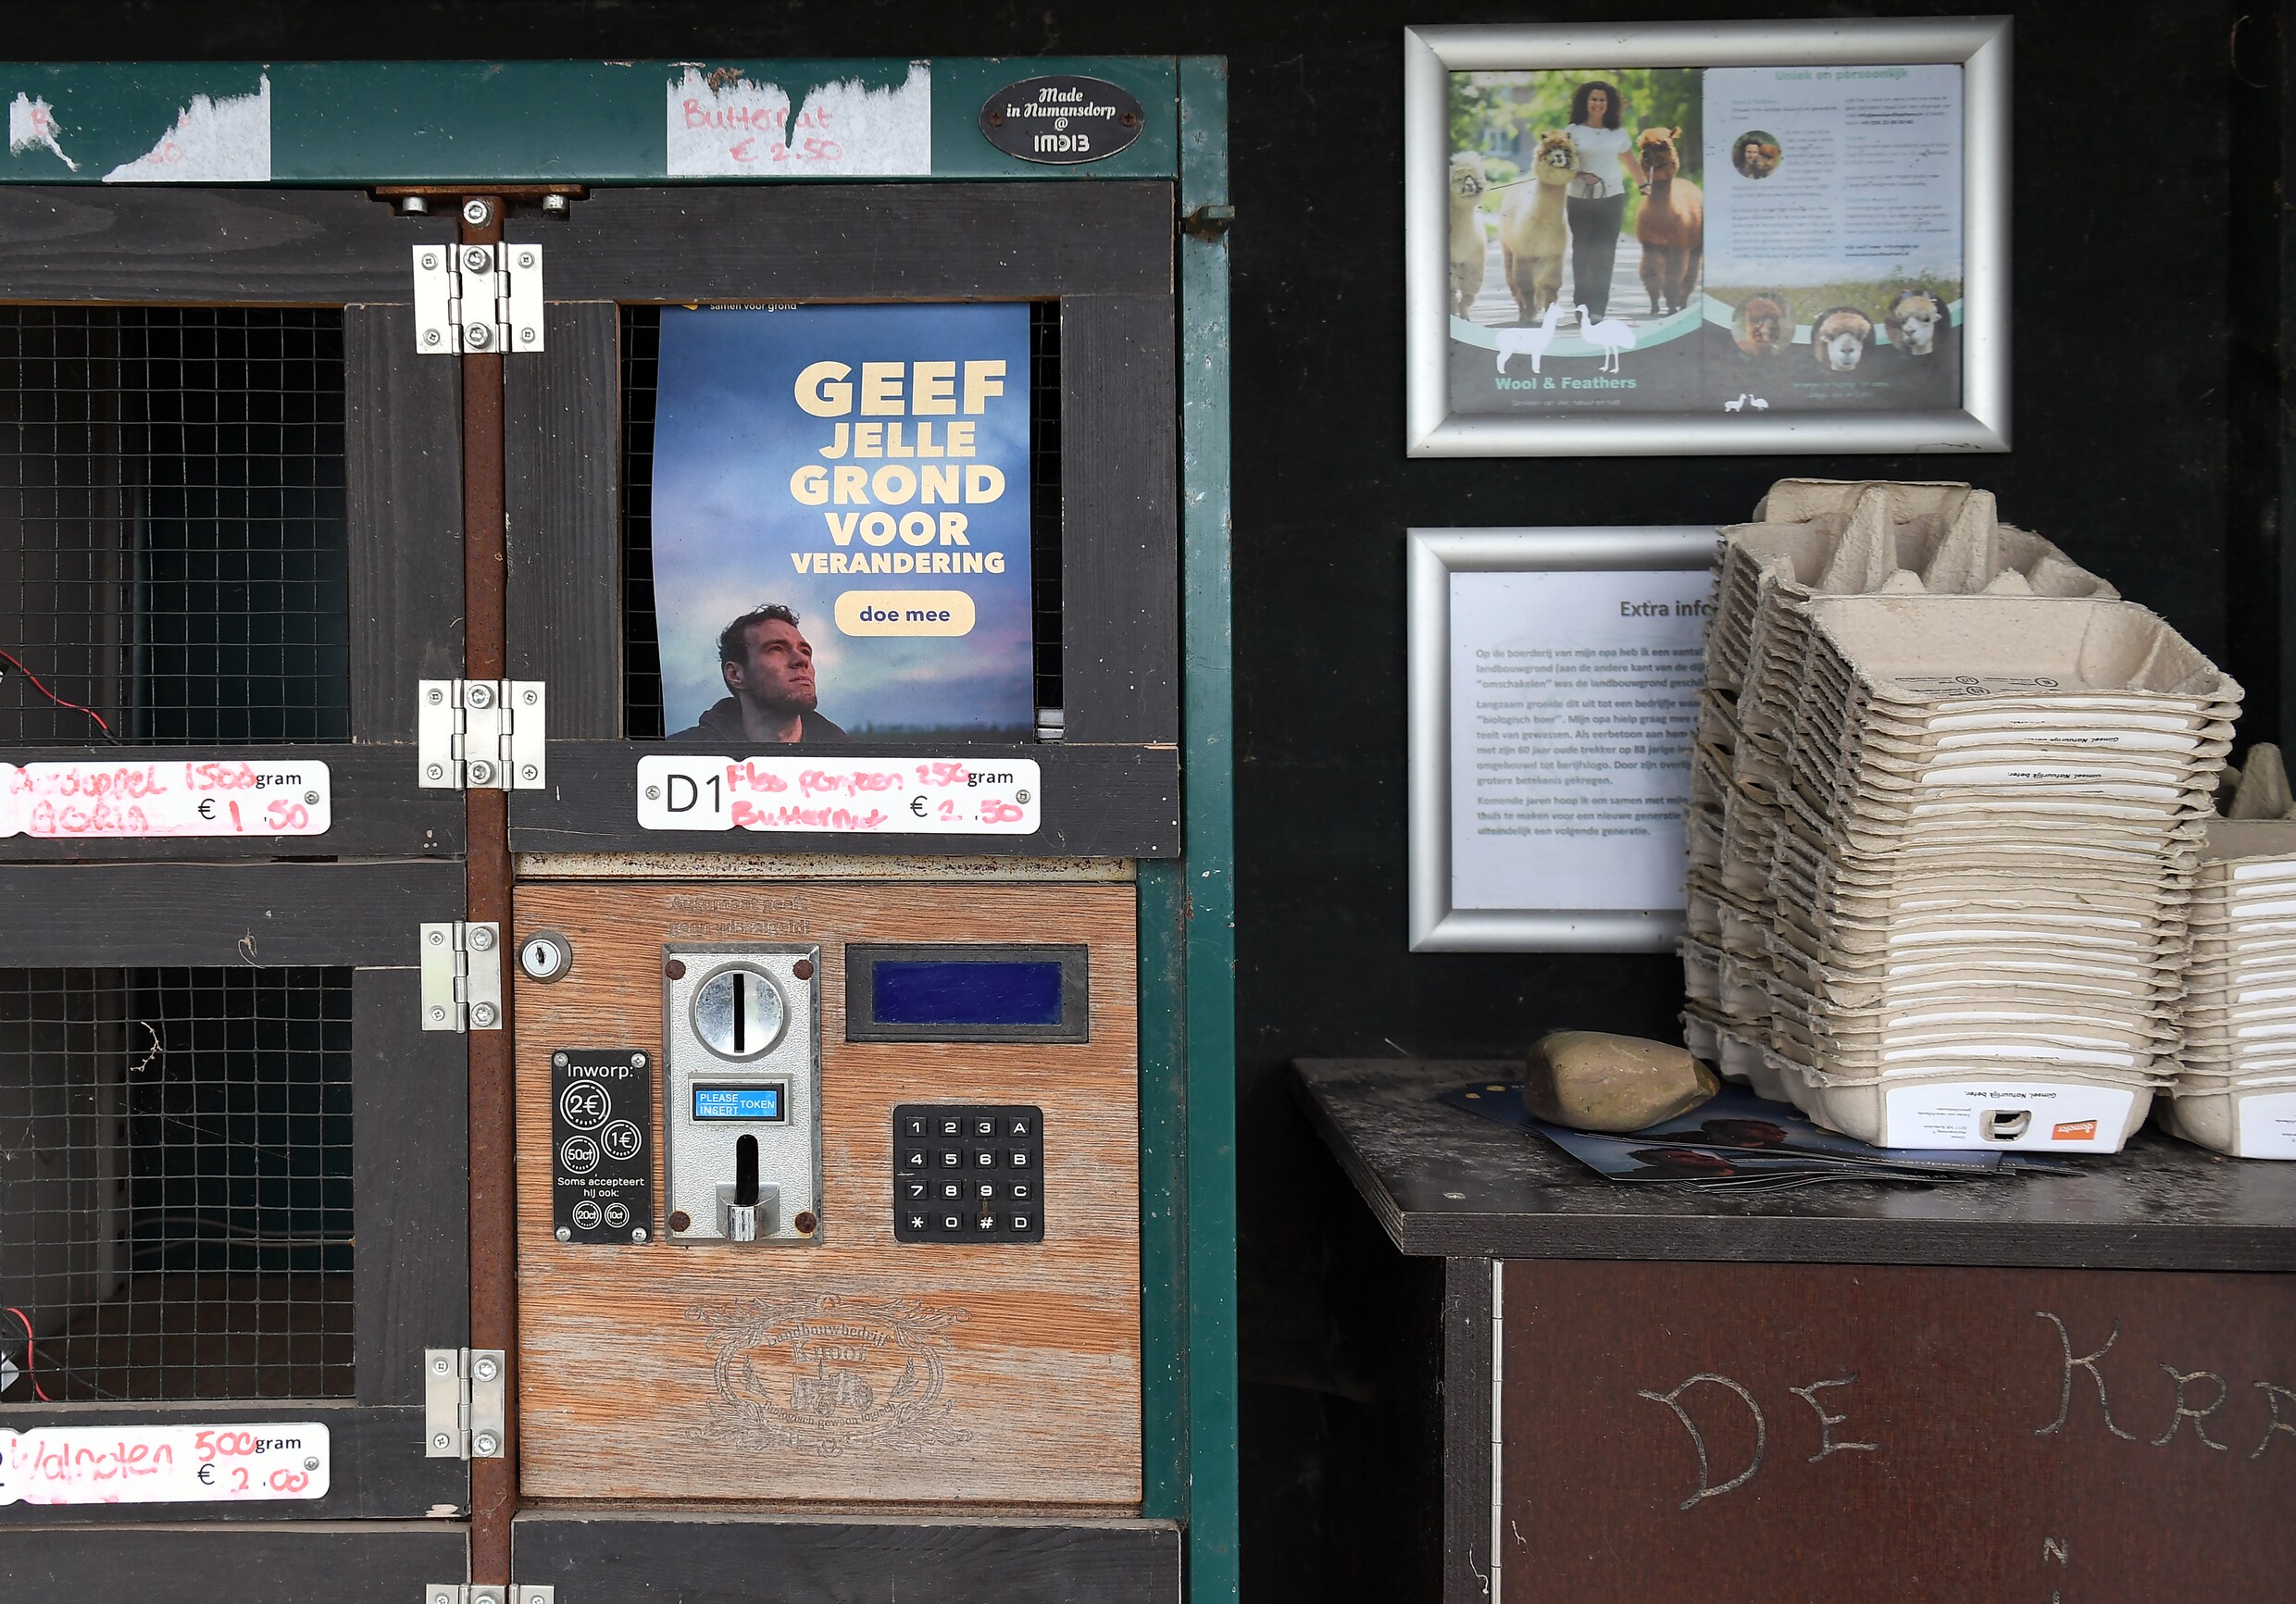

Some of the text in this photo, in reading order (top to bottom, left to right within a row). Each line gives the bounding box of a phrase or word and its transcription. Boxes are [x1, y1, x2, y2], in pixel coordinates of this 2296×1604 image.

[1039, 87, 1084, 103] Made
[1006, 102, 1117, 120] in Numansdorp
[1054, 118, 1068, 131] @
[729, 137, 844, 163] € 2.50
[794, 359, 1006, 417] GEEF
[1495, 376, 1638, 390] Wool & Feathers
[818, 421, 976, 460] JELLE
[790, 465, 1006, 506] GROND
[824, 511, 971, 547] VOOR
[790, 551, 1005, 575] VERANDERING
[859, 605, 951, 622] doe mee
[1620, 600, 1670, 617] Extra
[256, 775, 302, 790] gram
[667, 774, 721, 813] D1
[967, 772, 1014, 788] gram
[198, 798, 217, 820] €
[910, 795, 929, 818] €
[568, 1063, 634, 1080] Inworp:
[570, 1095, 600, 1116] 2€
[700, 1093, 775, 1109] PLEASE TOKEN
[700, 1106, 739, 1116] INSERT
[912, 1123, 1026, 1134] 1 2 3 A
[611, 1131, 632, 1149] 1€
[568, 1149, 593, 1161] 50ct
[910, 1153, 1027, 1165] 4 5 6 B
[557, 1176, 645, 1187] Soms accepteert
[598, 1188, 619, 1197] ook:
[910, 1185, 1027, 1197] 7 8 9 C
[578, 1210, 597, 1220] 20ct
[1015, 1217, 1028, 1228] D
[767, 1323, 892, 1347] Landbouwbedrijf
[762, 1400, 815, 1425] Biologisch
[256, 1438, 302, 1453] gram
[1637, 1372, 1880, 1511] DE
[197, 1463, 216, 1486] €
